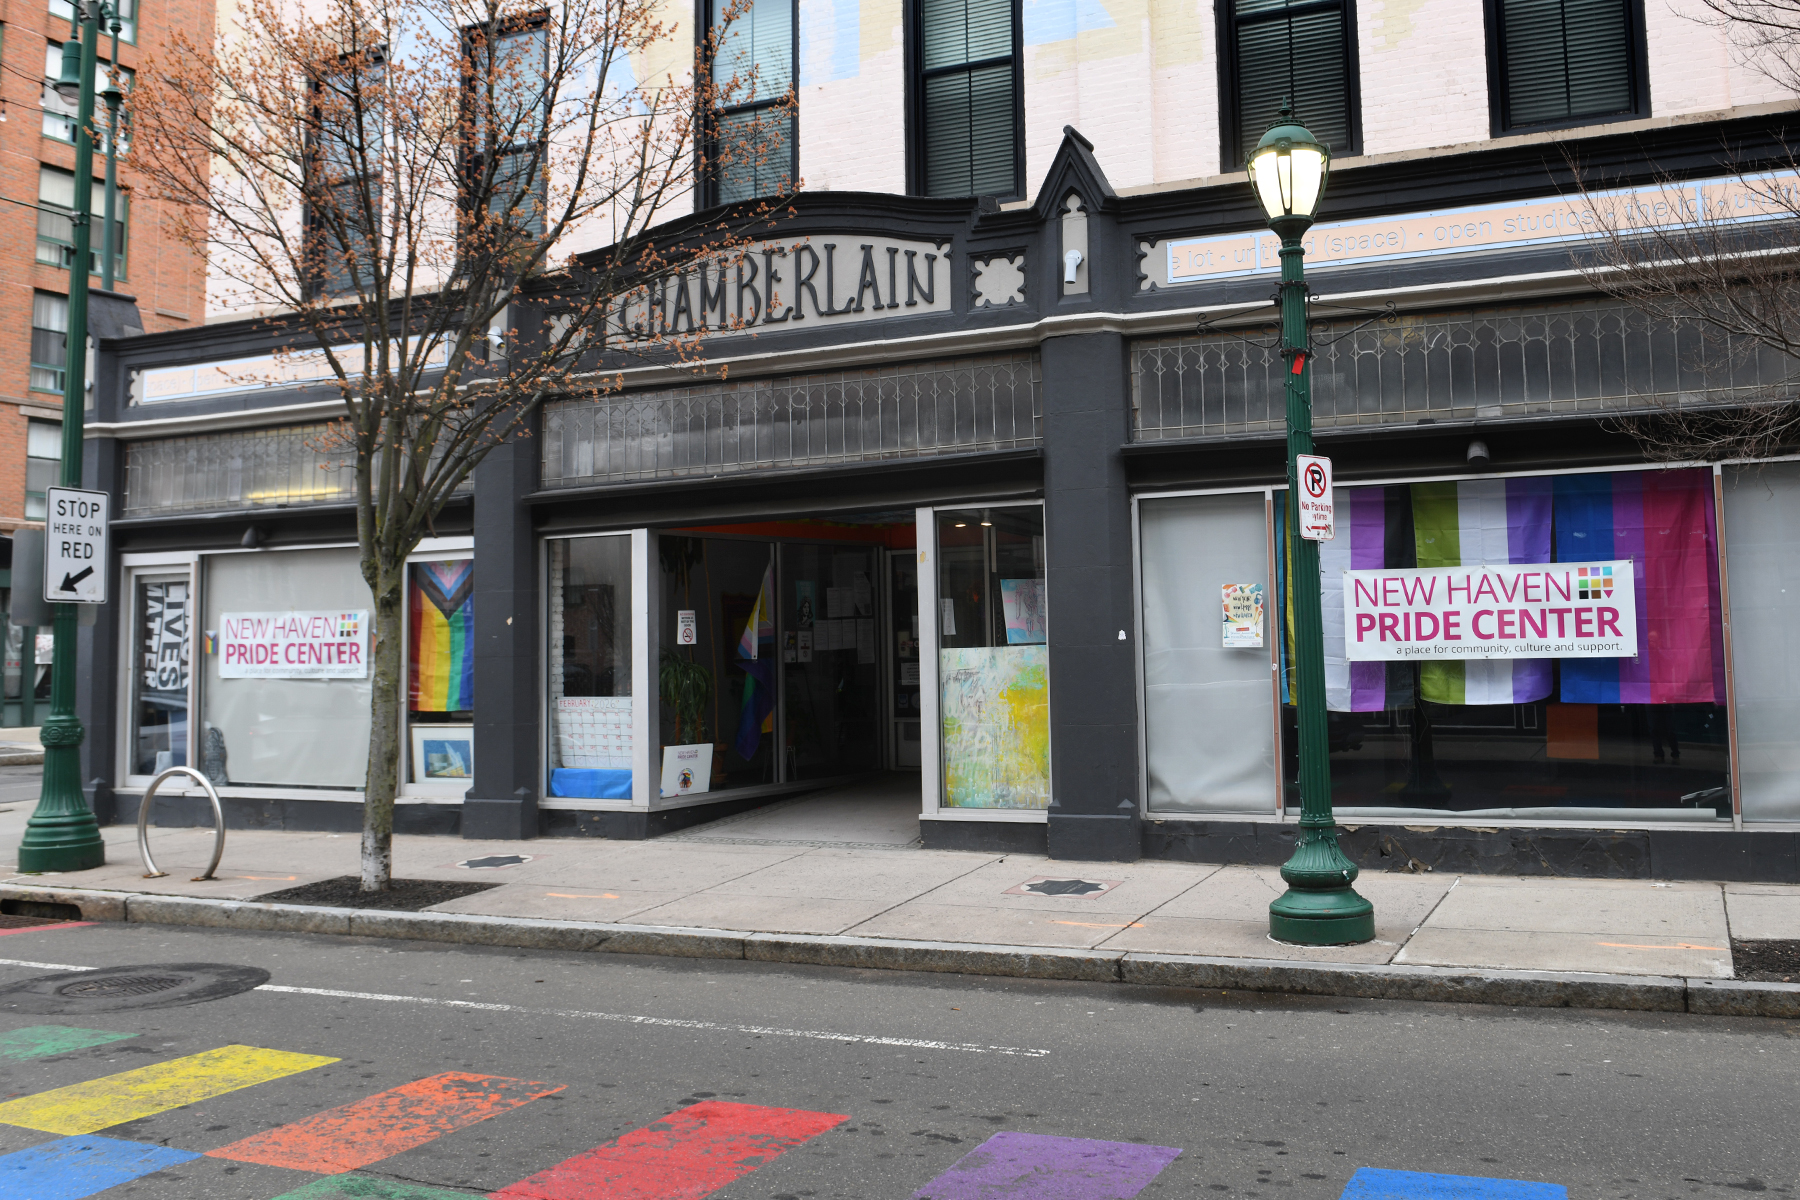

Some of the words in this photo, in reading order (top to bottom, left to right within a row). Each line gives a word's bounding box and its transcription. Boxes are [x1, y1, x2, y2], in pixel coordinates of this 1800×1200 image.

[1188, 249, 1214, 268] lot
[1324, 227, 1406, 257] (space)
[1434, 220, 1492, 245] open
[1503, 208, 1595, 234] studios
[1625, 200, 1668, 221] the
[617, 242, 937, 339] CHAMBERLAIN
[57, 499, 100, 519] STOP
[1301, 501, 1309, 510] No
[1311, 502, 1332, 514] Parking
[53, 522, 82, 535] HERE
[88, 525, 102, 536] ON
[61, 541, 93, 559] RED
[1354, 576, 1437, 607] NEW
[1447, 571, 1571, 605] HAVEN
[159, 582, 184, 688] LIVES
[226, 618, 269, 639] NEW
[273, 617, 337, 639] HAVEN
[1356, 611, 1461, 642] PRIDE
[1471, 607, 1624, 640] CENTER
[225, 643, 279, 665] PRIDE
[284, 642, 361, 664] CENTER
[1405, 645, 1431, 656] place
[1434, 645, 1449, 654] for
[1451, 644, 1511, 655] community,
[1515, 643, 1551, 652] culture
[1554, 642, 1574, 651] and
[1577, 642, 1623, 653] support.
